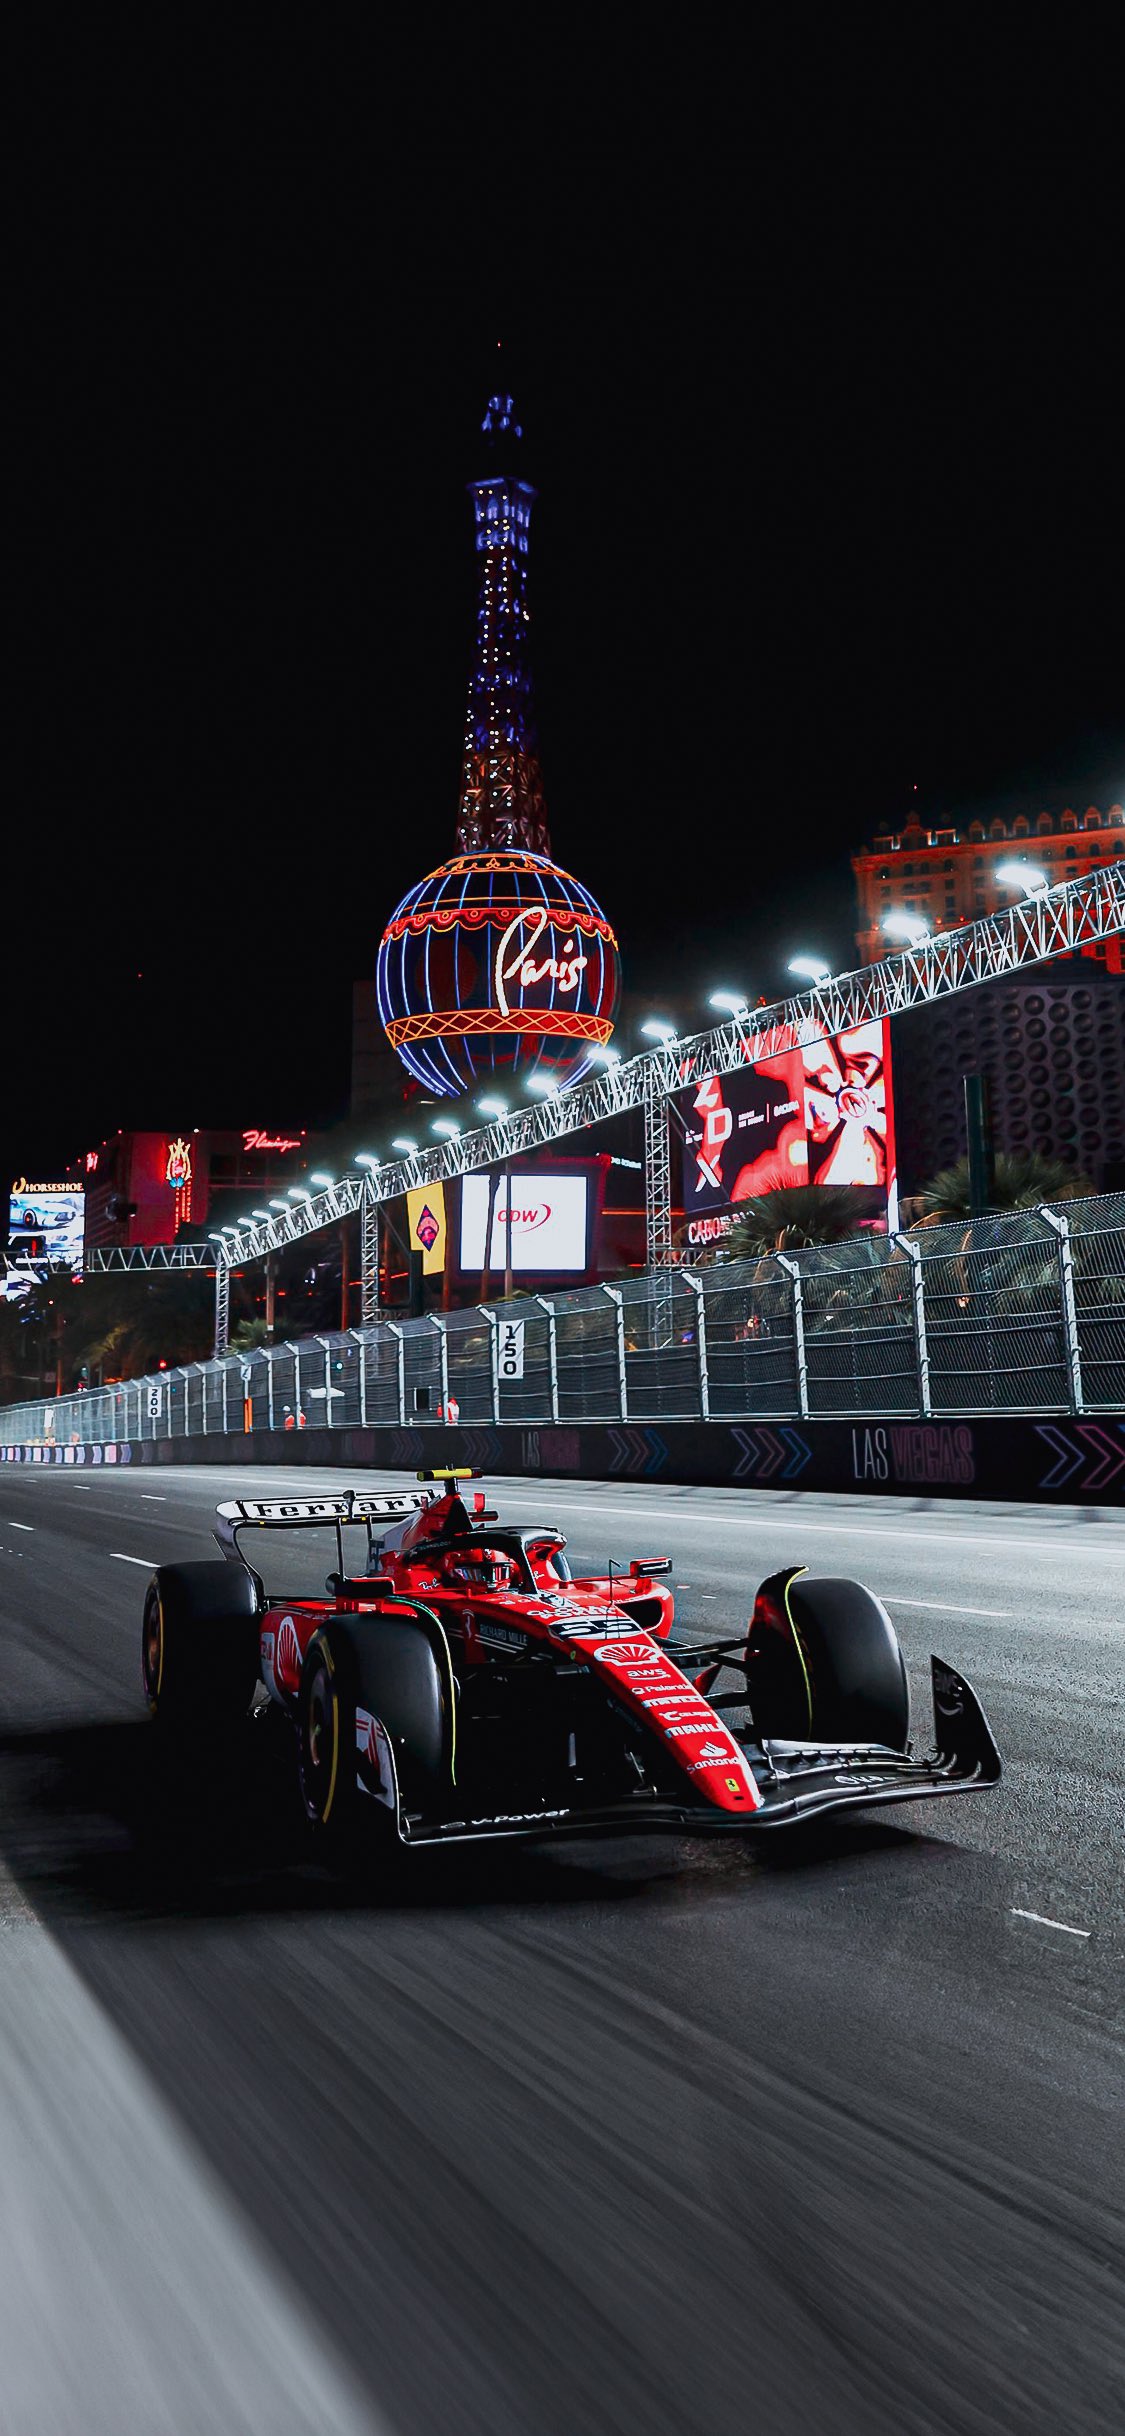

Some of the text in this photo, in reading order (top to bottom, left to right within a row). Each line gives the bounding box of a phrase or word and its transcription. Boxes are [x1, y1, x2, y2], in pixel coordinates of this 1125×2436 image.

[496, 906, 588, 1016] Paris
[503, 1325, 517, 1375] 150
[150, 1388, 159, 1416] 200
[852, 1425, 976, 1484] LAS VEGAS
[253, 1496, 421, 1517] Ferrari
[627, 1668, 667, 1677] aws
